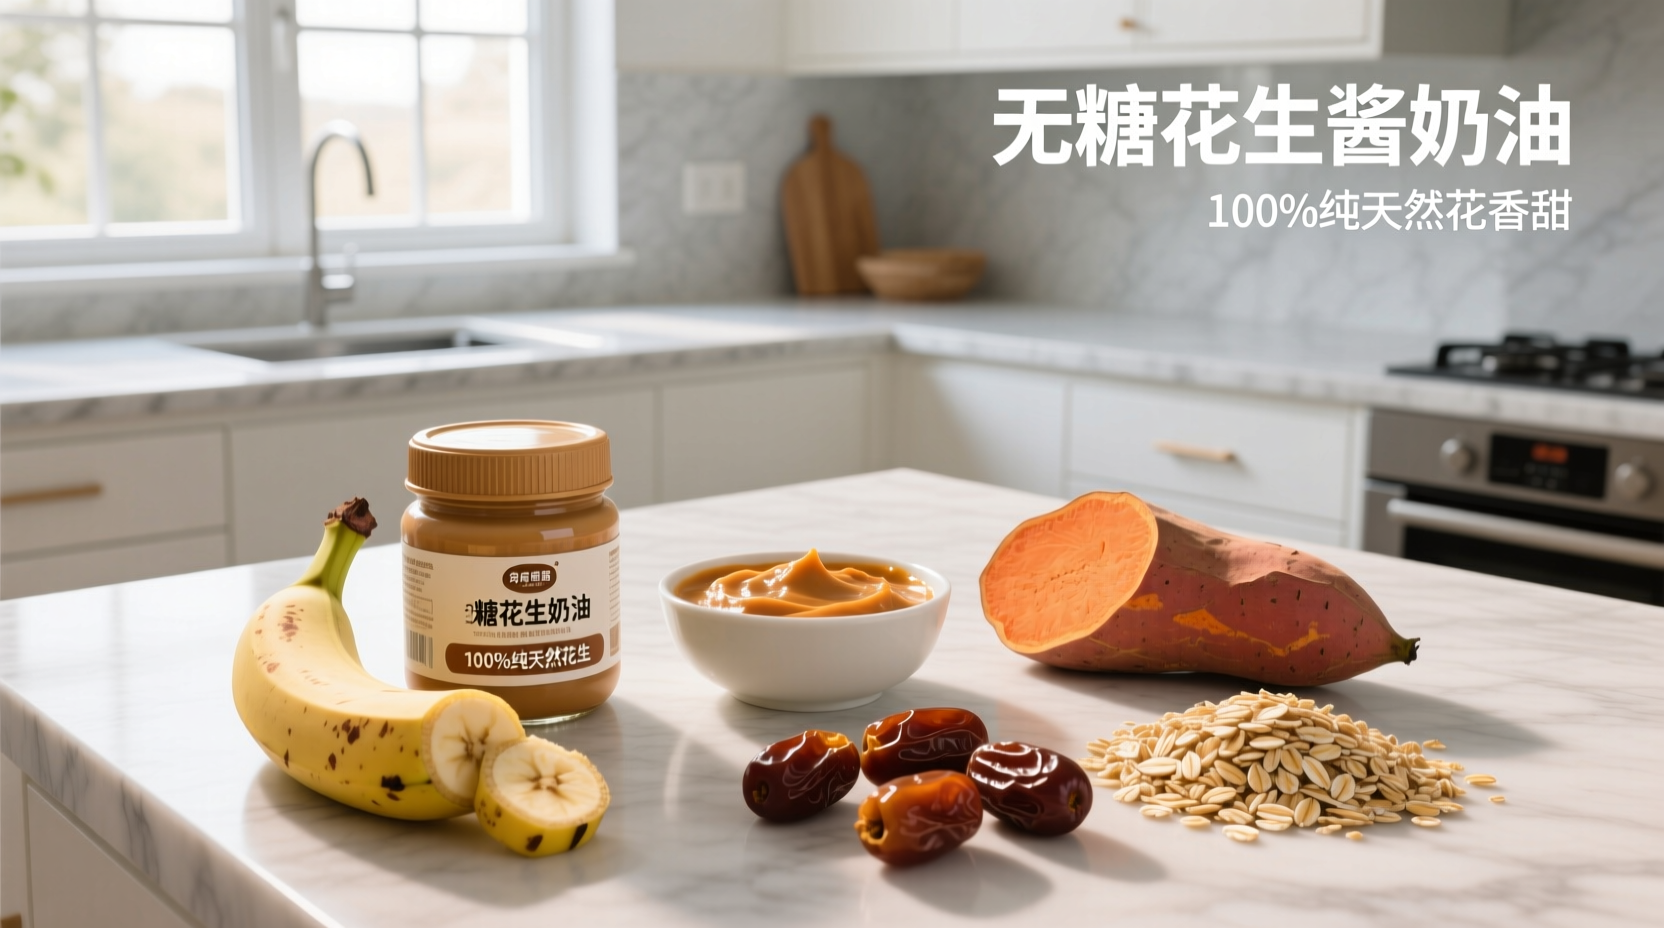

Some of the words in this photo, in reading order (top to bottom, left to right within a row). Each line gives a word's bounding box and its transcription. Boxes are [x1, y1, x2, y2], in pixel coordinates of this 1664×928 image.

[464, 643, 591, 670] 100%纯天然花生
